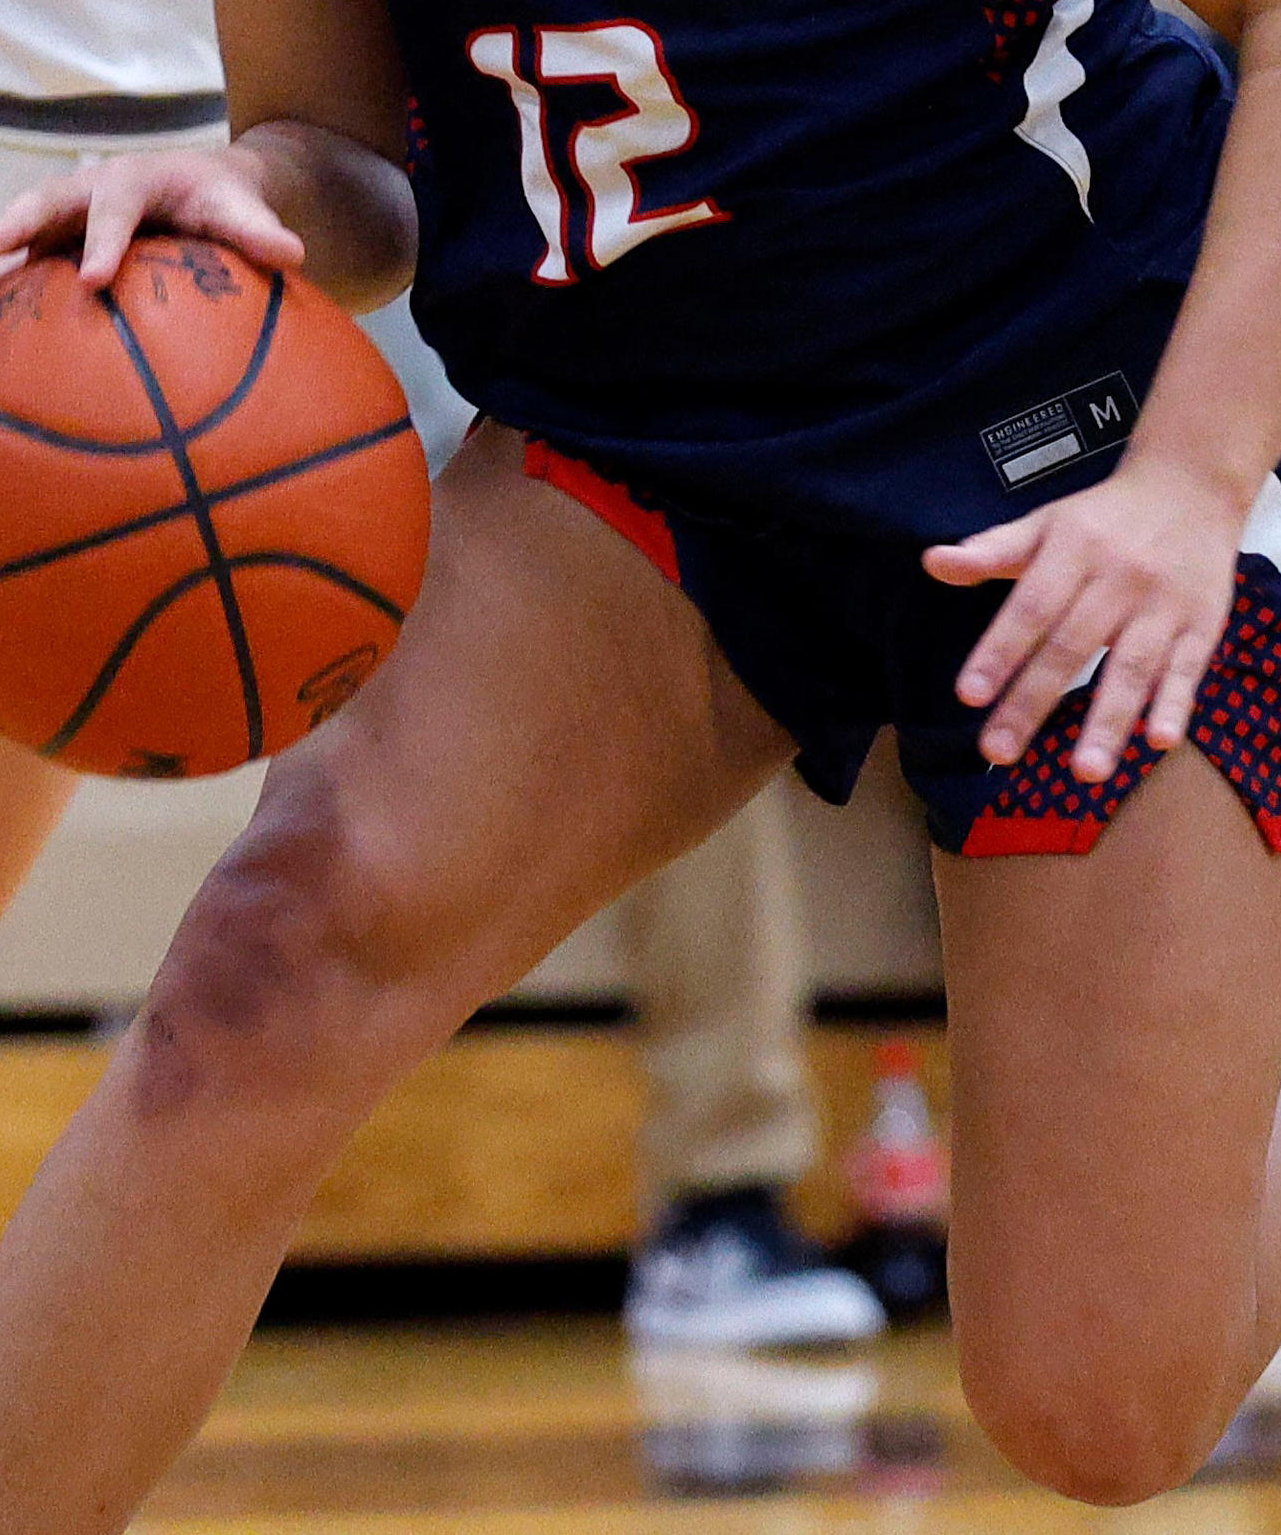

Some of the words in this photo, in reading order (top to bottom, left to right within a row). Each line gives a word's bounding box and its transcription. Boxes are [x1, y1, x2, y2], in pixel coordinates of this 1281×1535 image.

[466, 18, 733, 287] 12
[987, 402, 1065, 444] ENGINEERED
[1088, 395, 1122, 430] M
